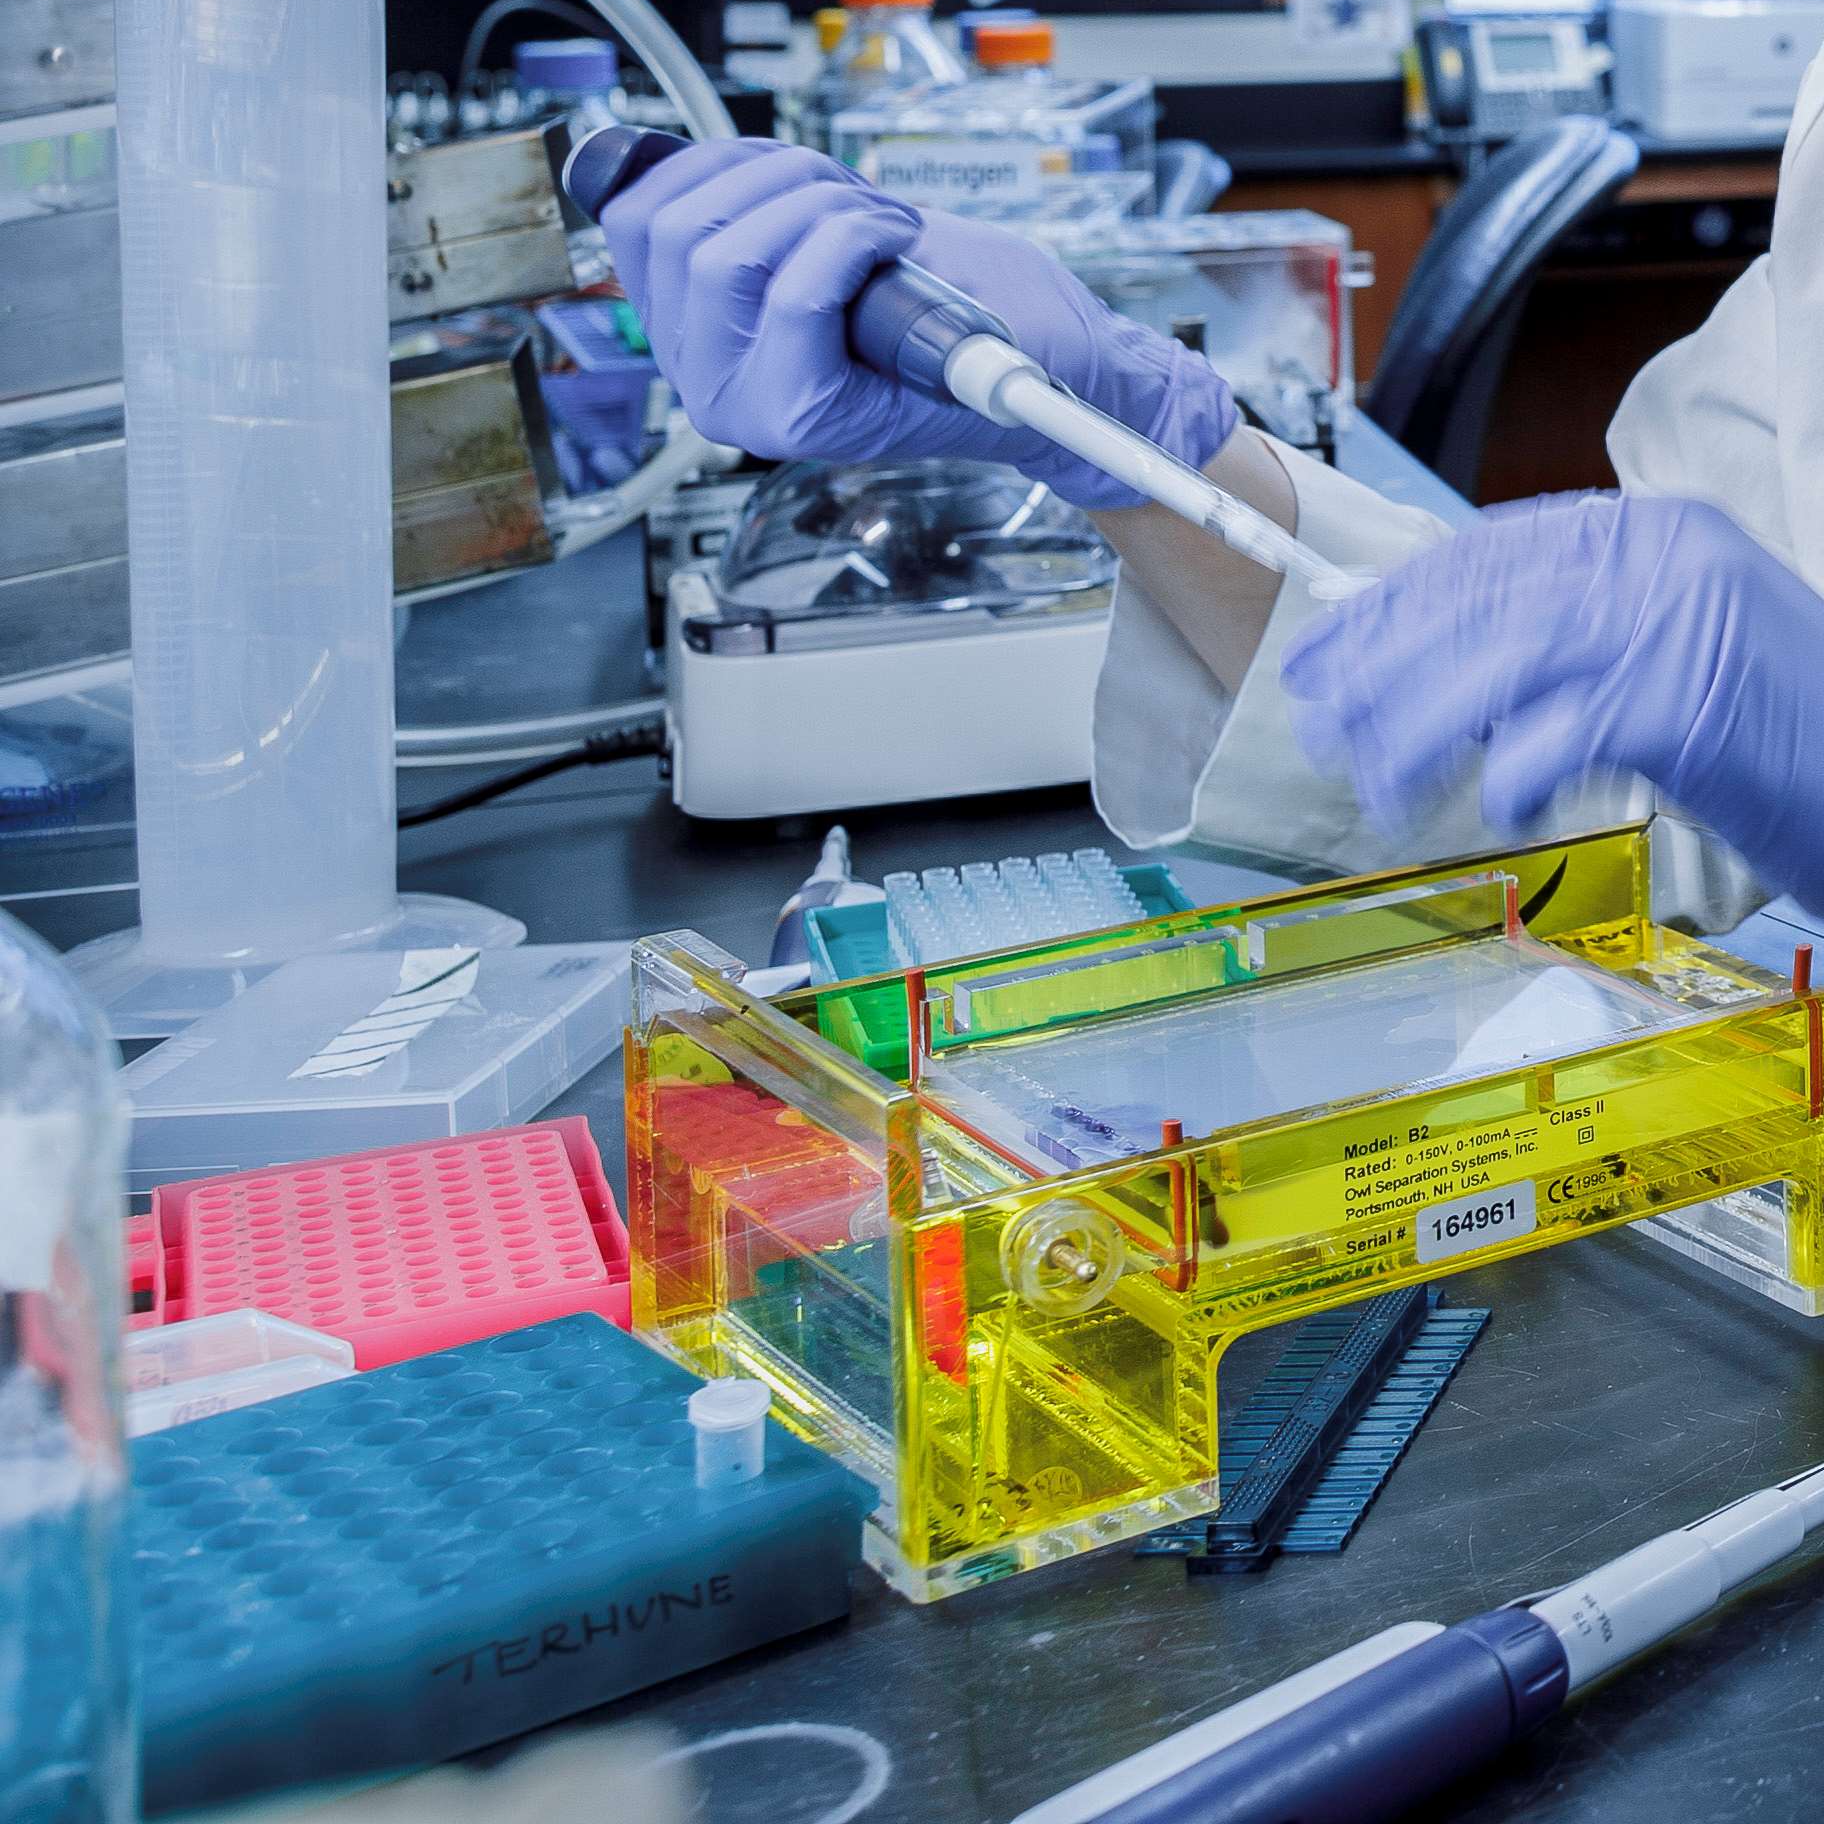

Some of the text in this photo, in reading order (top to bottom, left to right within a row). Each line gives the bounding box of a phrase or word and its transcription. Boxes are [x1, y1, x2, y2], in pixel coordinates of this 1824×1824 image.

[1344, 1125, 1430, 1161] Model: B2
[1549, 1107, 1592, 1126] Class
[1344, 1127, 1512, 1182] Rated: 0-150V, 0-100mA
[1344, 1140, 1539, 1202] Owl Separation Systems, Inc.
[1345, 1171, 1491, 1222] Portsmouth, NH USA
[1346, 1198, 1516, 1256] Serial # 164961
[432, 1574, 737, 1686] TERHUNE
